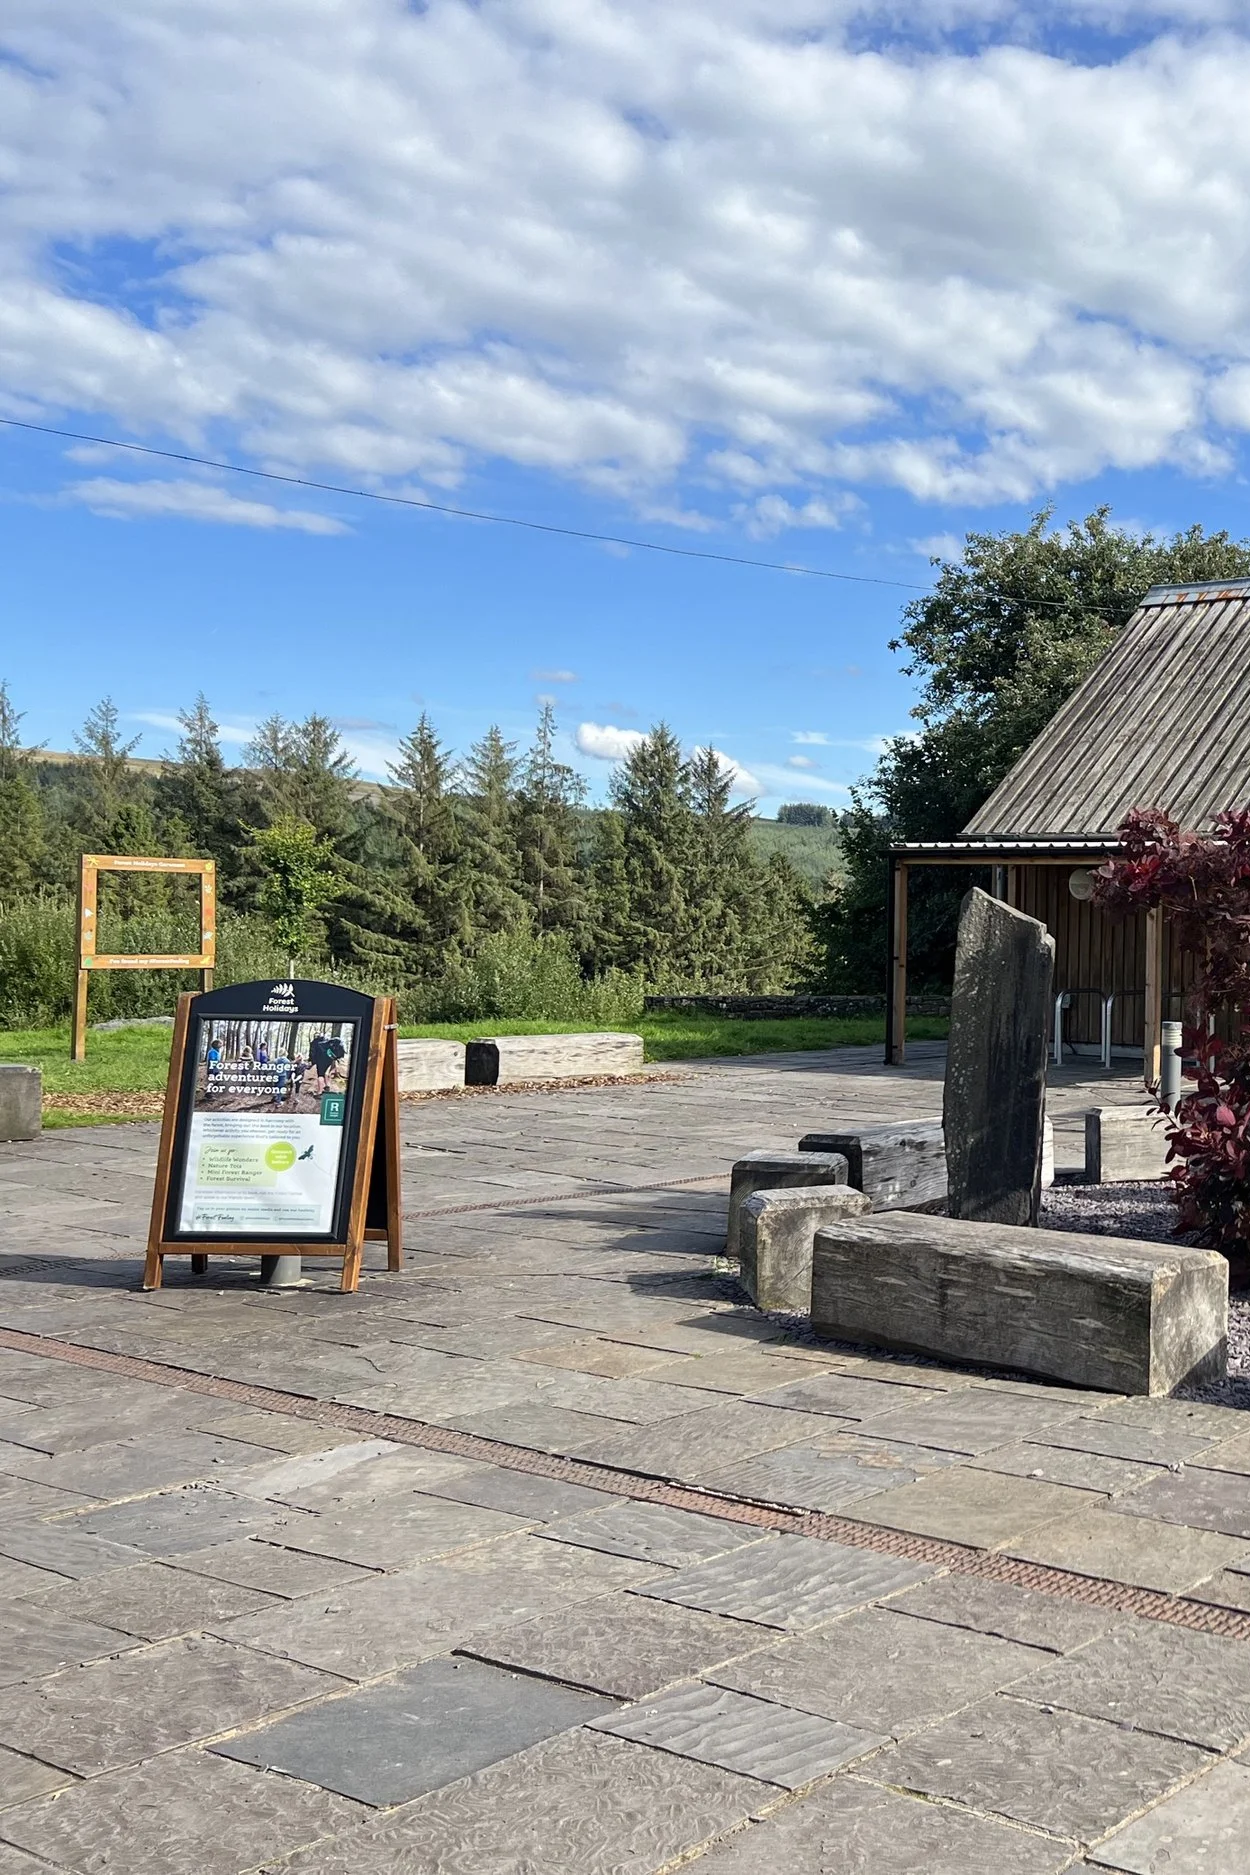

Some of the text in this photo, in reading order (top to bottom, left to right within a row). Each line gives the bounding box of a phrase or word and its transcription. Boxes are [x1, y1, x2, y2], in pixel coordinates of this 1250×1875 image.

[268, 997, 295, 1005] Forest
[262, 1005, 299, 1013] Holidays
[209, 1061, 298, 1073] Forest Ranger
[208, 1072, 279, 1083] adventures
[206, 1083, 287, 1096] for everyone
[330, 1102, 339, 1111] R
